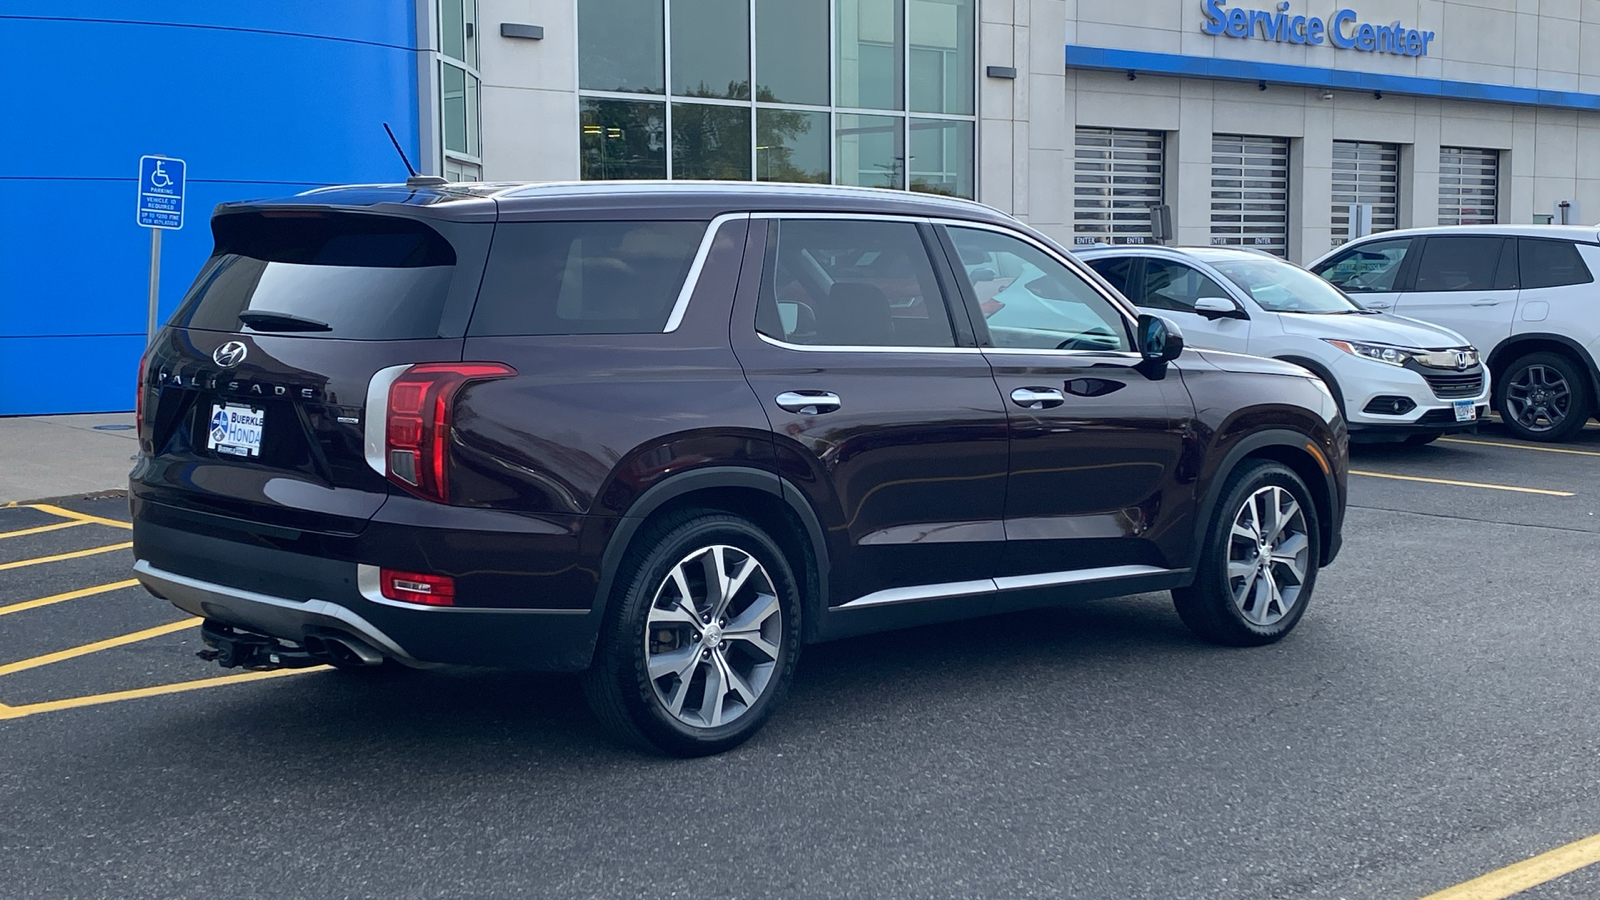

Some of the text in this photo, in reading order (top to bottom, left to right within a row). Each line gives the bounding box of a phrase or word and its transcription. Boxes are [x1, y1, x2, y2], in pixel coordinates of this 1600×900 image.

[1201, 0, 1435, 56] Service Center
[1254, 237, 1271, 245] ENTER
[159, 373, 314, 398] PALISADE
[228, 424, 260, 444] HONDA
